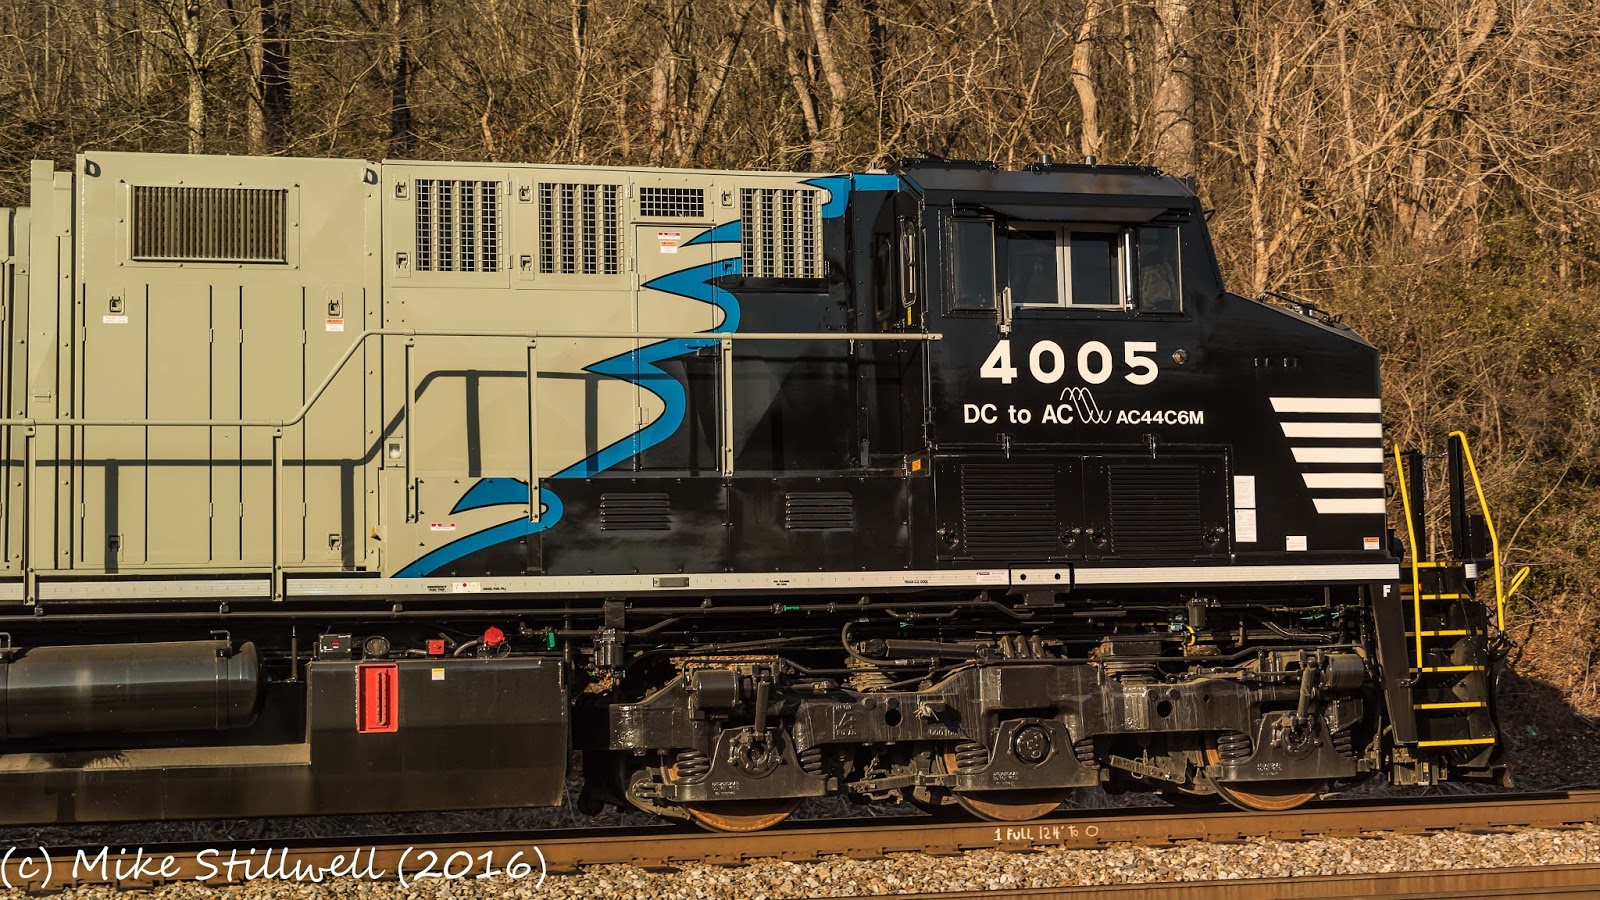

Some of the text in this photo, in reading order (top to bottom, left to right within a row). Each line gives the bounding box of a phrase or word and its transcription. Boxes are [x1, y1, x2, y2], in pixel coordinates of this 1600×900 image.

[979, 339, 1160, 386] 4005
[963, 403, 1205, 425] DC to AC AC44C6M
[1382, 584, 1392, 598] F
